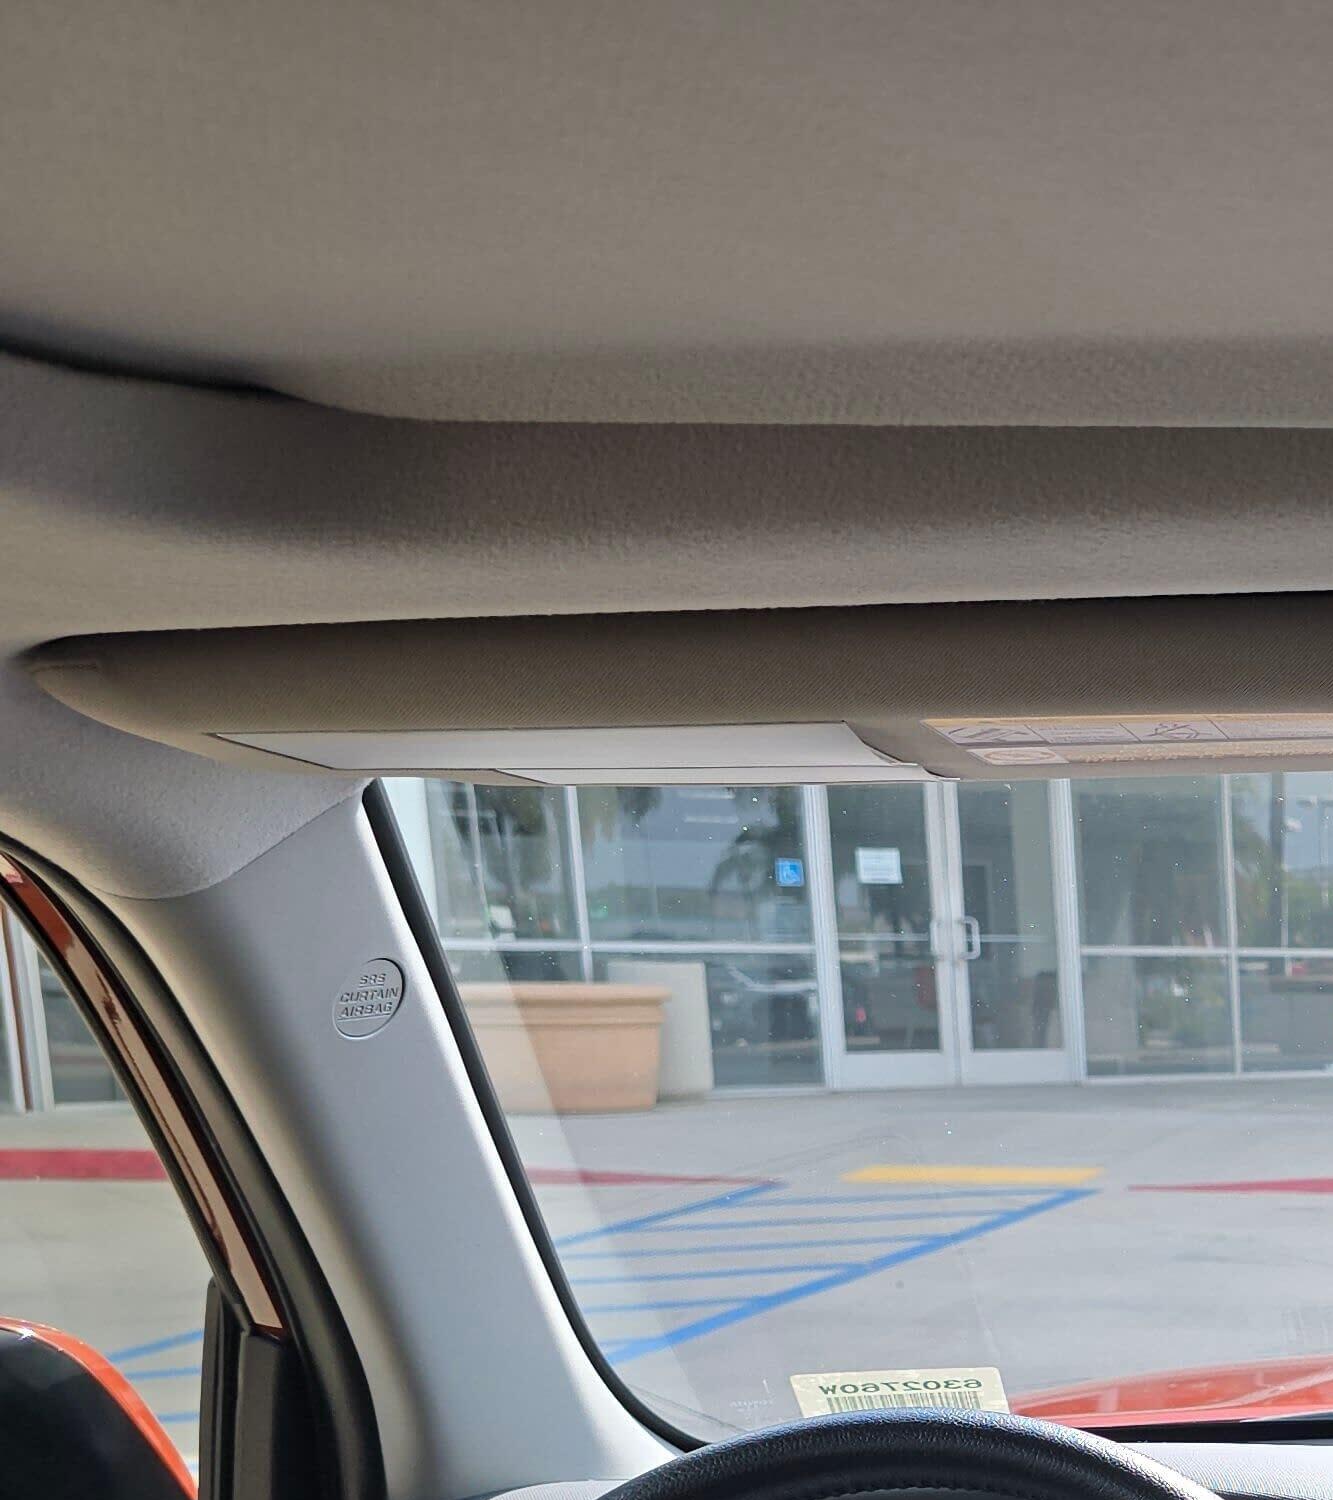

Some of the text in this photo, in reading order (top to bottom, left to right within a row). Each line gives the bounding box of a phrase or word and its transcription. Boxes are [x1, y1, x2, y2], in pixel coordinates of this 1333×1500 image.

[360, 973, 386, 986] SRS
[340, 987, 399, 1004] CURTAIN
[339, 1002, 393, 1019] AIRBAG
